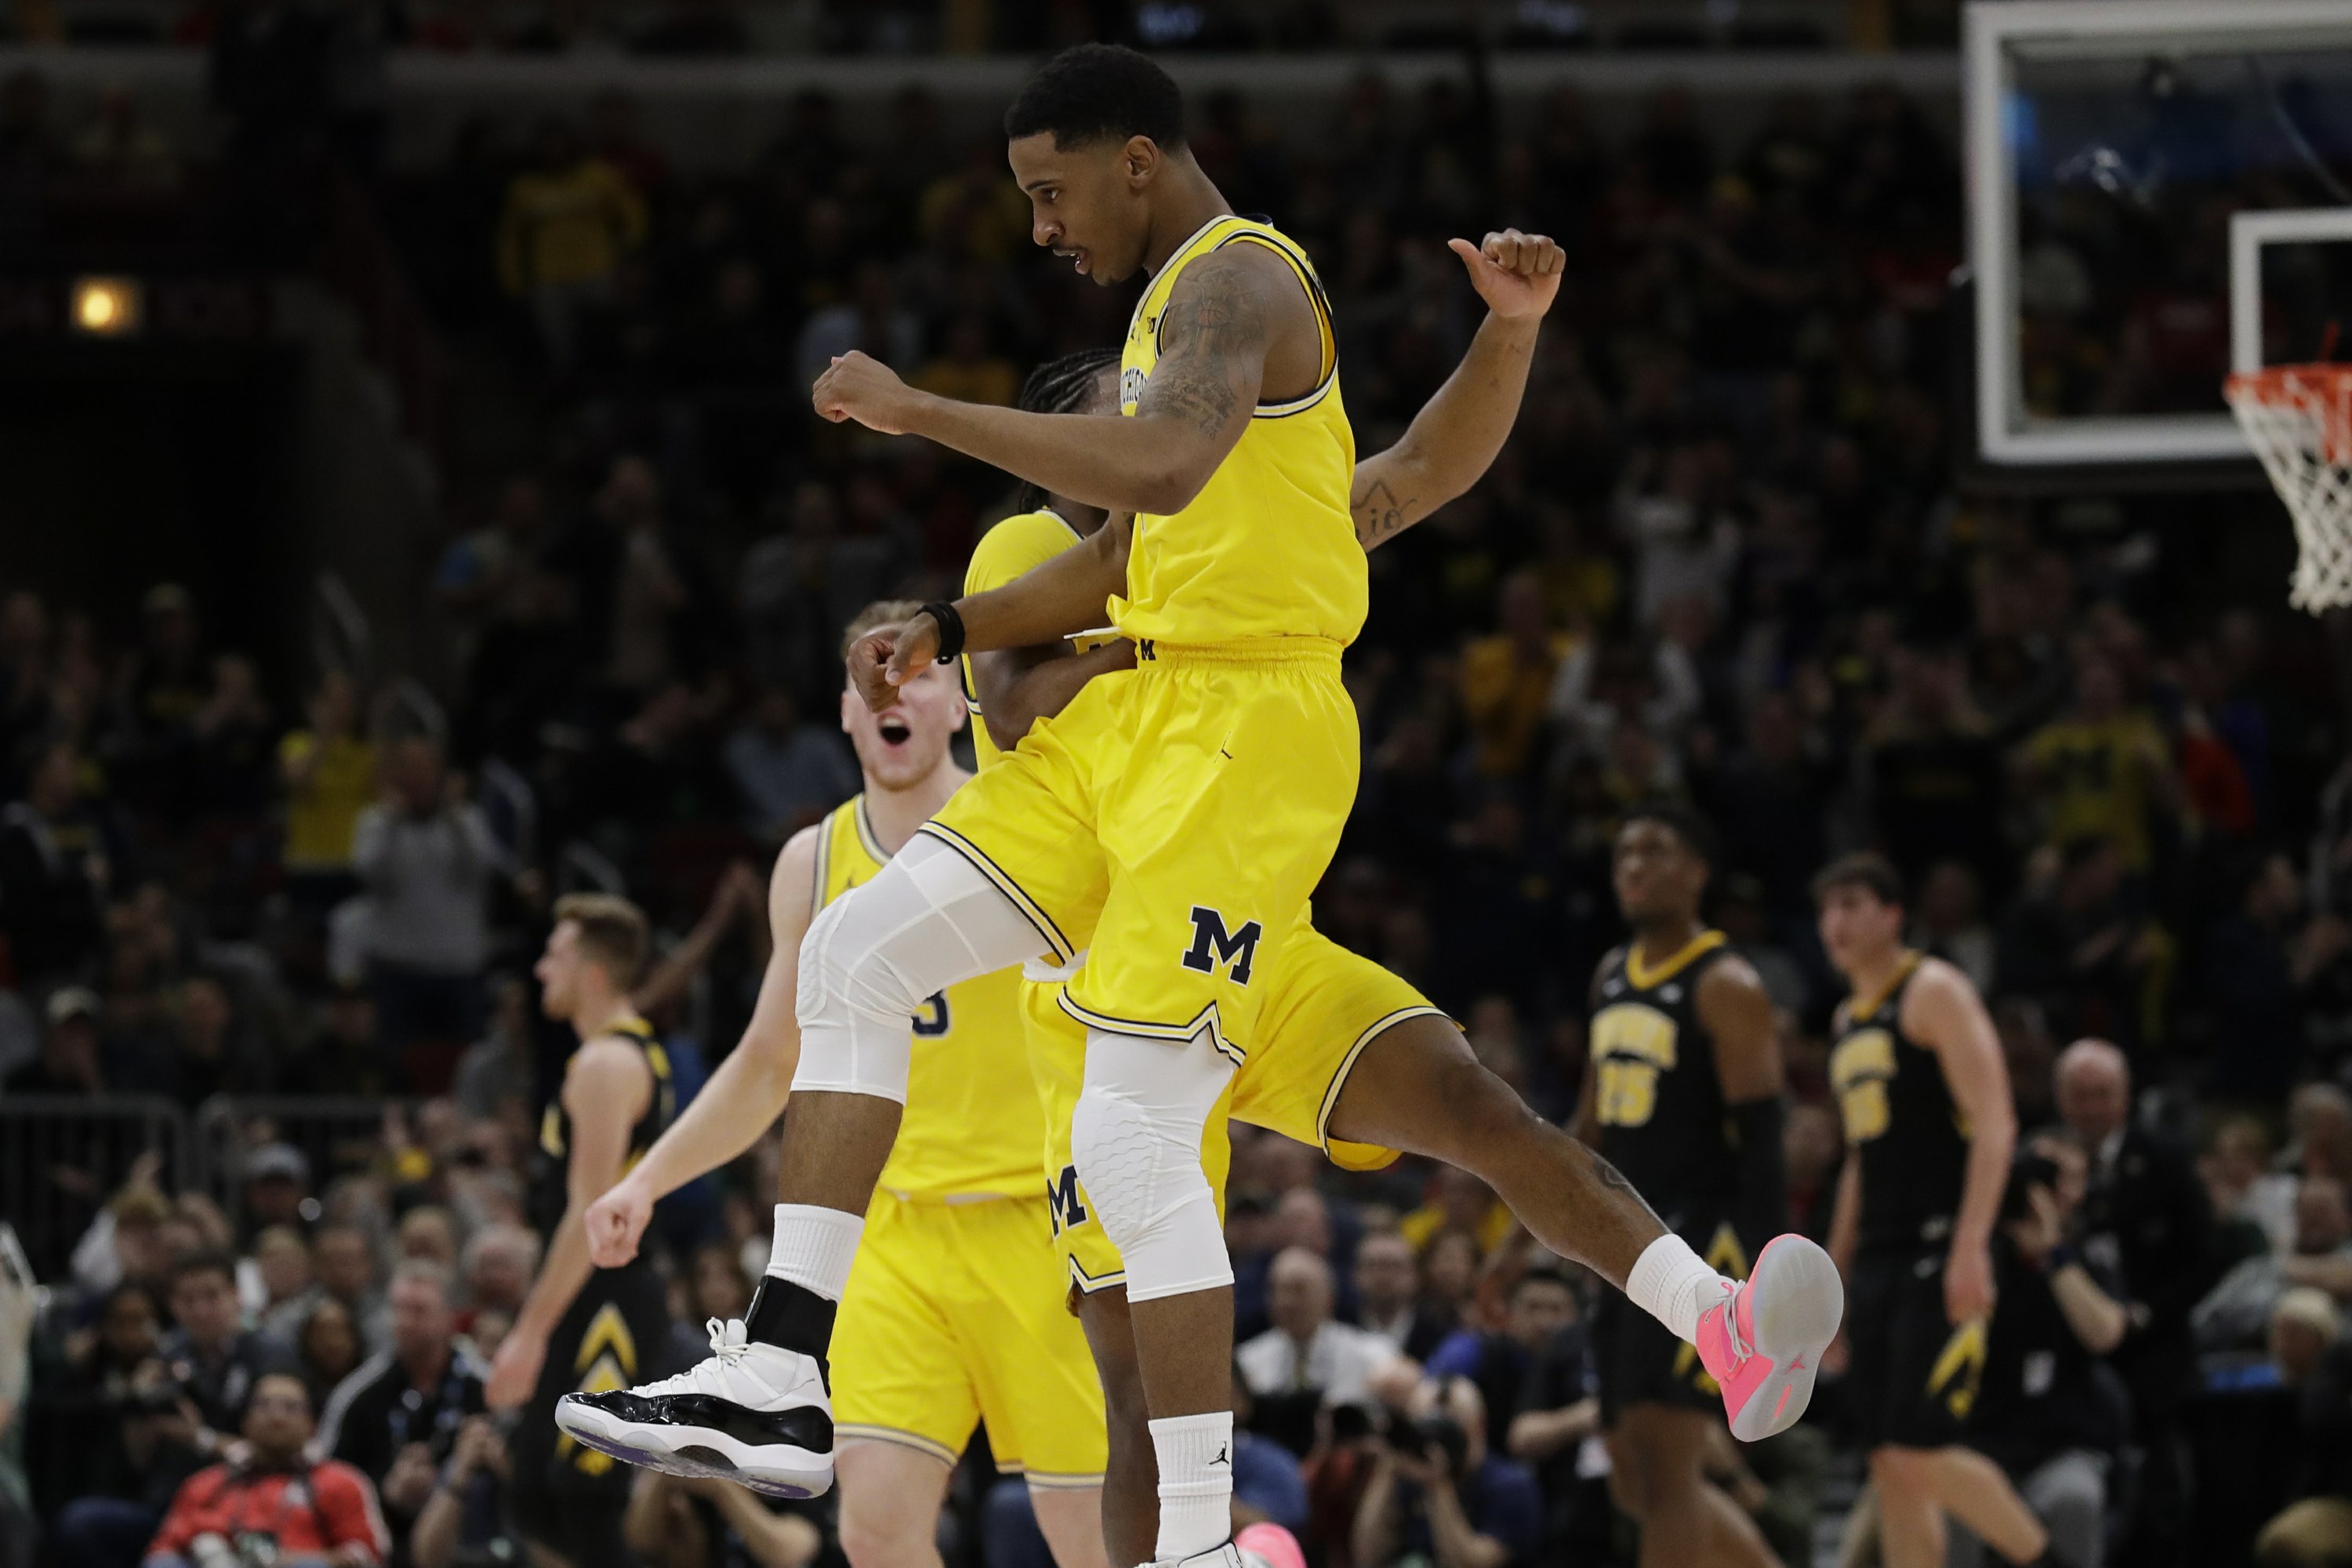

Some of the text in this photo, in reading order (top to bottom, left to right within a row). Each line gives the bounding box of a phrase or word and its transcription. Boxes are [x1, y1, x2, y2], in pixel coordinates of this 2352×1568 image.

[1140, 638, 1156, 661] M
[1181, 904, 1263, 987] M
[1047, 1165, 1087, 1237] M
